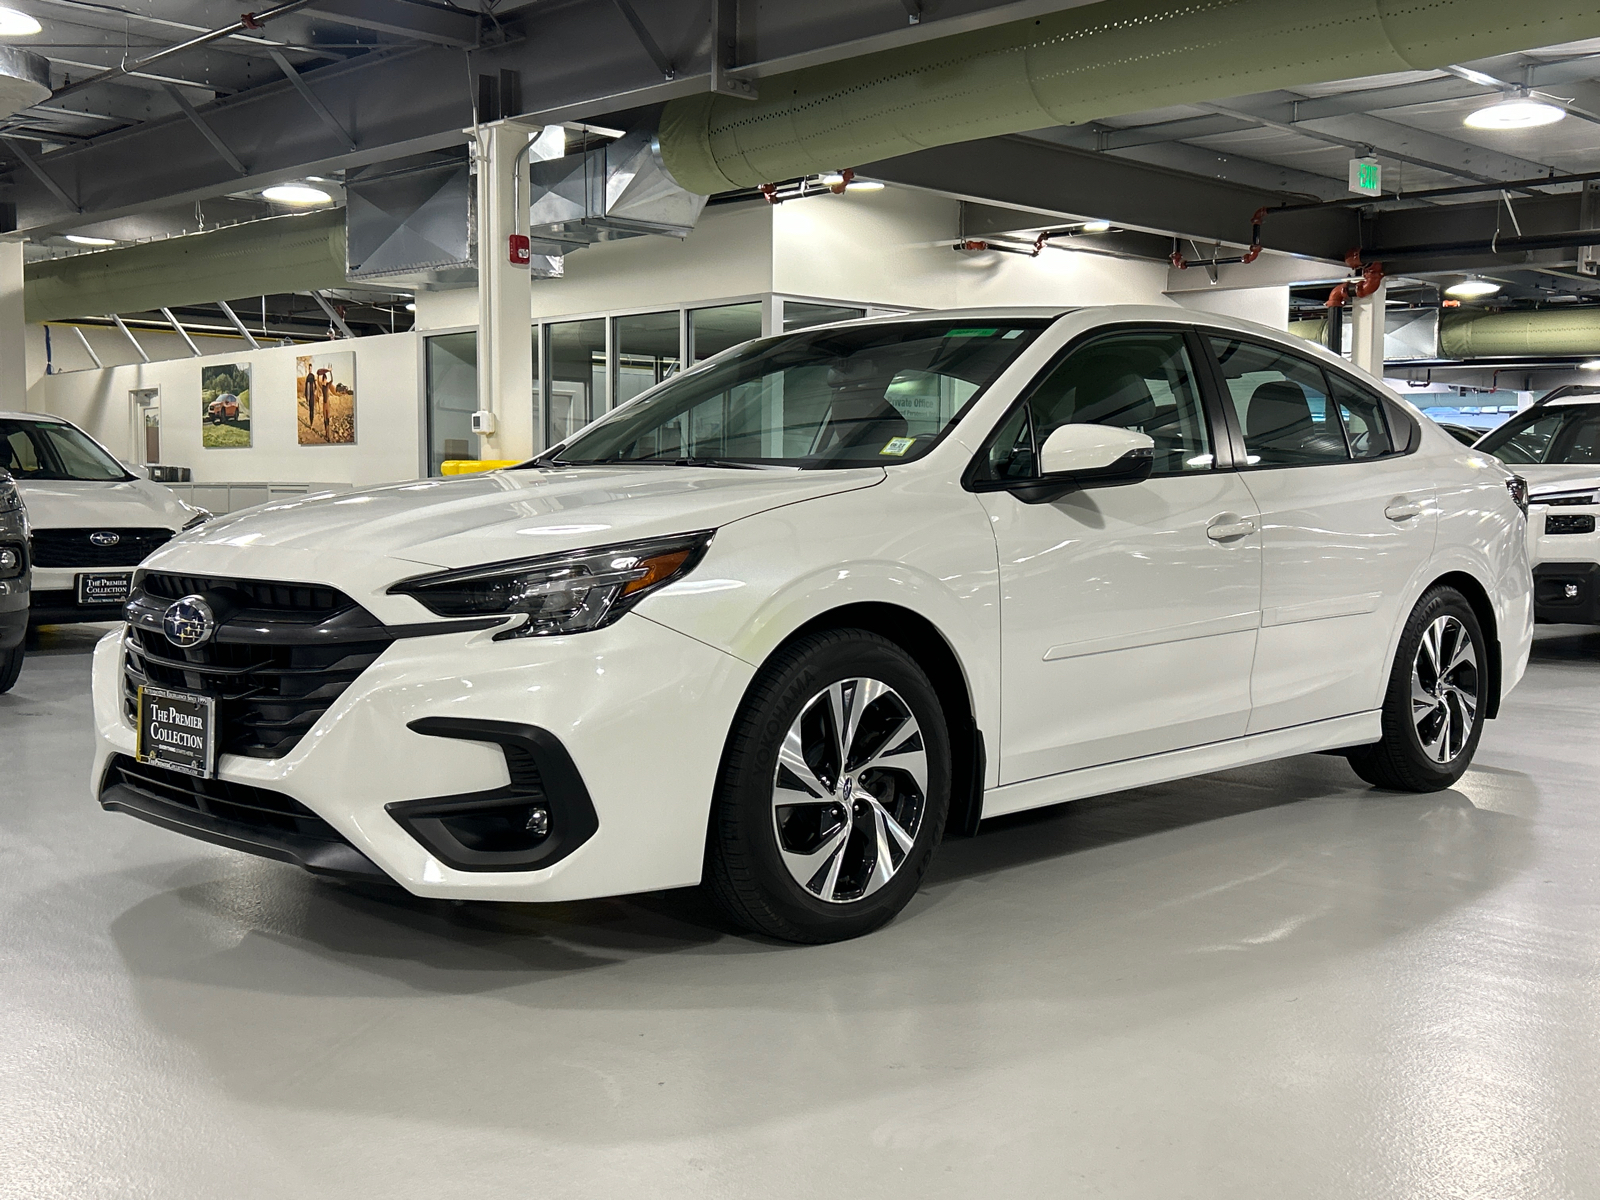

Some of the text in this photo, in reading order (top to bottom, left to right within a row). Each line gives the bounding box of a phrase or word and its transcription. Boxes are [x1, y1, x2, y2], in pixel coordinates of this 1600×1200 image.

[1359, 163, 1378, 190] EXIT
[914, 398, 934, 409] Office
[86, 586, 127, 594] COLLECTION
[1408, 599, 1440, 656] YOKOHAMA
[150, 703, 203, 730] THE PREMIER
[150, 721, 203, 750] COLLECTION
